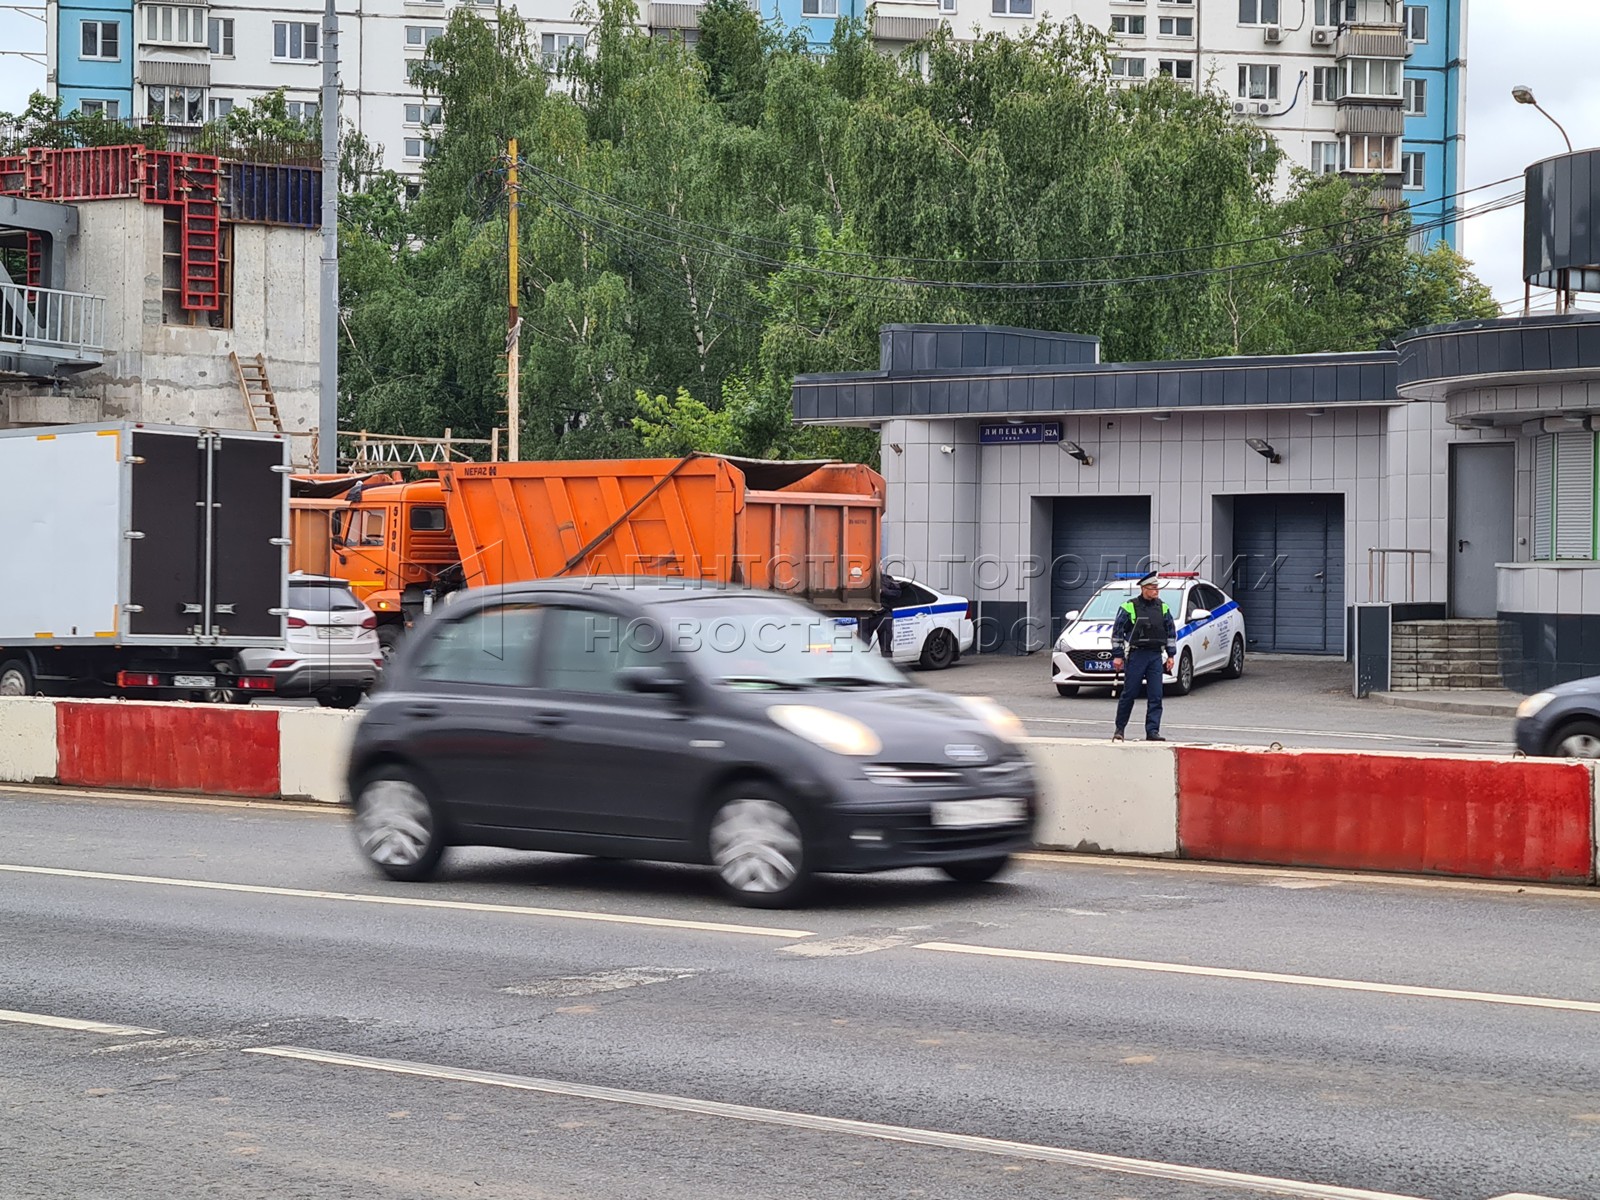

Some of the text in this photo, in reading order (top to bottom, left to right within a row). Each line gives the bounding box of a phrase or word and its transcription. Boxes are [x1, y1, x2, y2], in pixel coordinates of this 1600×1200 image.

[985, 427, 1058, 437] ЛИПЕЦКАЯ 52А
[464, 466, 488, 476] NEFAZ
